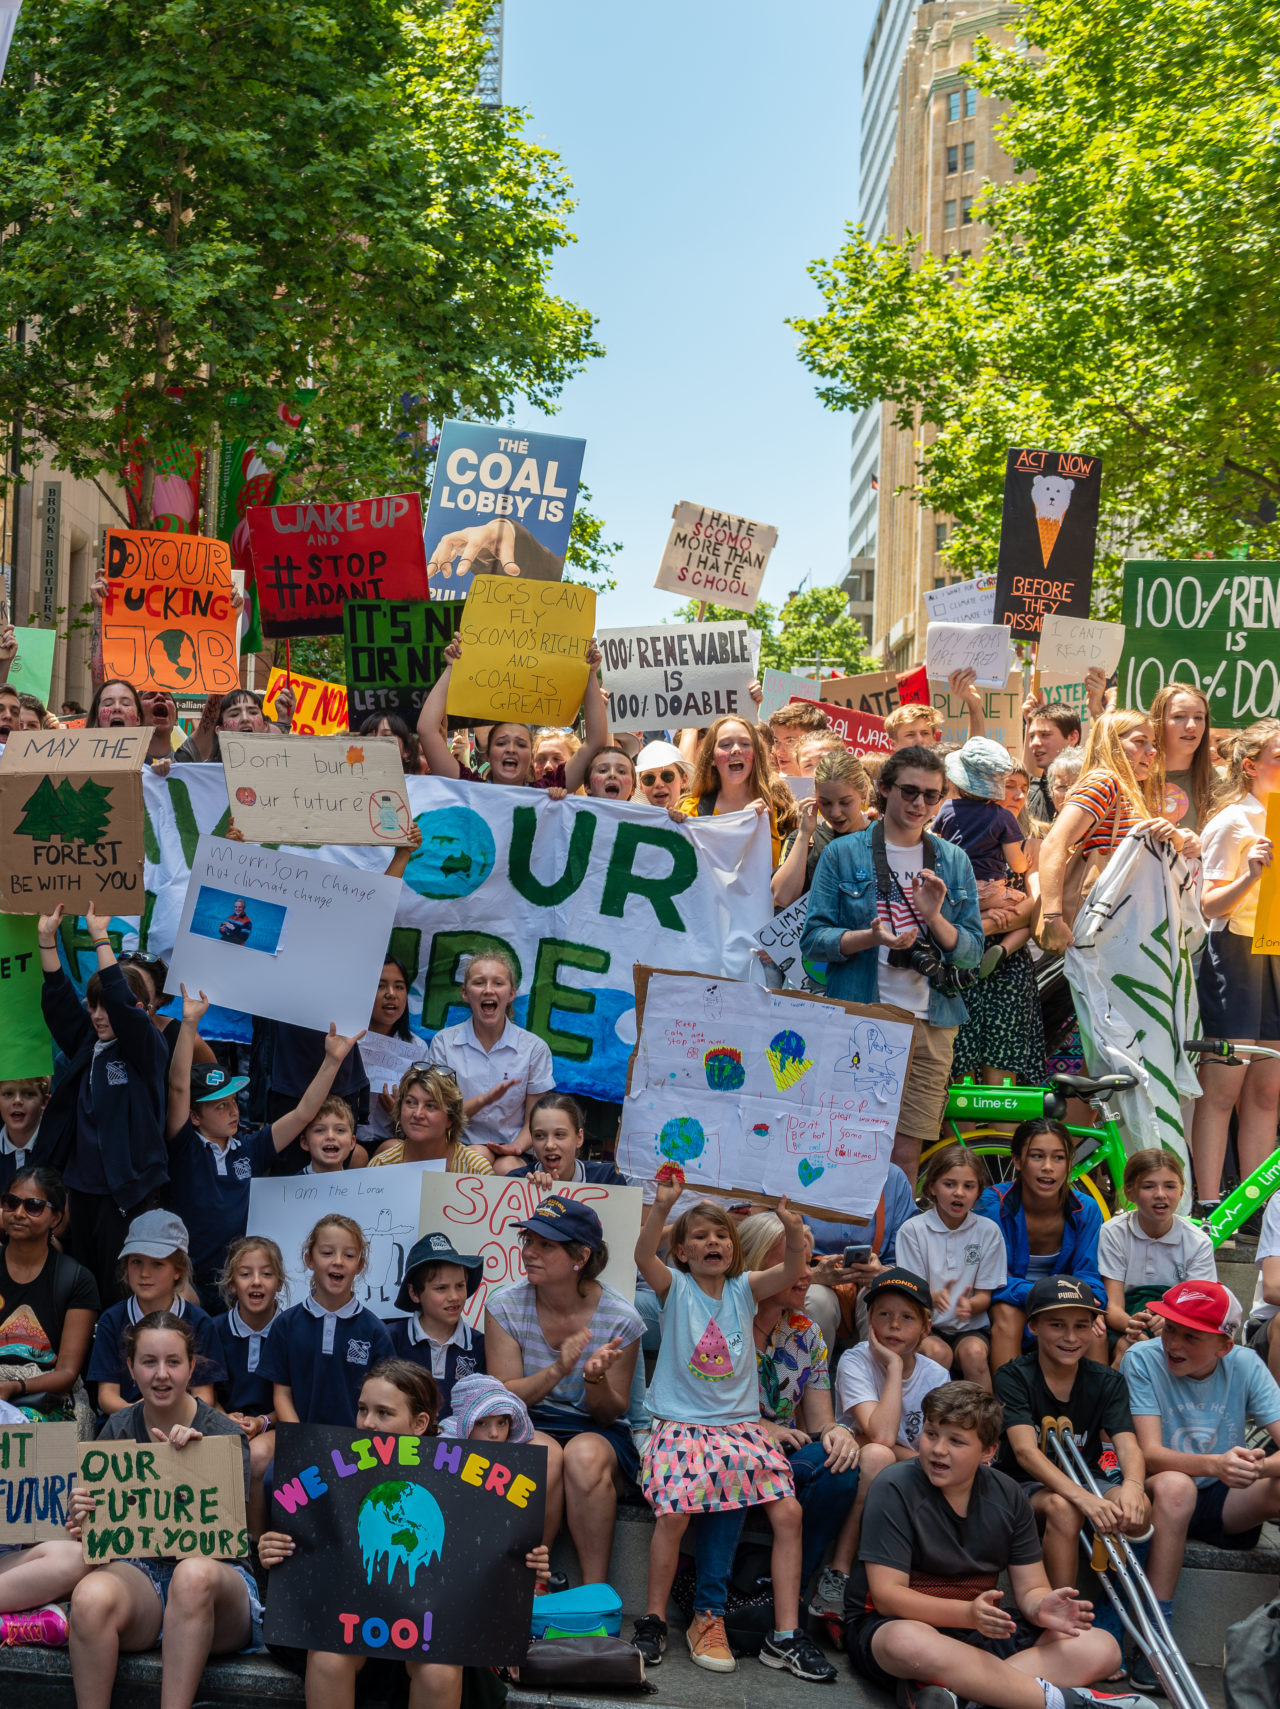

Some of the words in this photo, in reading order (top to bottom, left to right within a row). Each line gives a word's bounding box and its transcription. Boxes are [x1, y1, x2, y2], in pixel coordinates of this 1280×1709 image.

[497, 437, 530, 454] THE
[445, 447, 569, 499] COAL
[1017, 450, 1049, 469] ACT
[1058, 454, 1094, 475] NOW
[47, 488, 56, 544] BROOKS
[270, 502, 363, 534] WAKE
[370, 497, 410, 528] UP
[439, 486, 533, 518] LOBBY
[538, 499, 565, 523] IS
[692, 522, 752, 551] SCOMO
[699, 508, 705, 522] I
[710, 511, 758, 538] HATE
[306, 533, 340, 547] AND
[674, 532, 721, 557] MORE
[727, 546, 766, 570] THAN
[108, 535, 140, 579] DO
[141, 537, 234, 587] YOUR
[307, 550, 388, 580] STOP
[697, 554, 745, 580] HATE
[43, 549, 54, 624] BROTHERS
[304, 578, 385, 606] ADANI
[471, 579, 531, 606] PIGS
[540, 586, 586, 613] CAN
[677, 567, 749, 597] SCHOOL
[1013, 576, 1075, 599] BEFORE
[104, 582, 230, 621] FUCKING
[1023, 598, 1060, 614] THEY
[348, 602, 412, 645] IT'S
[509, 608, 546, 626] FLY
[463, 624, 537, 650] SCOMO'S
[540, 632, 591, 656] RIGHT
[636, 629, 751, 669] RENEWABLE
[1056, 643, 1102, 659] READ
[1227, 631, 1248, 652] IS
[104, 624, 238, 692] JOB
[353, 645, 400, 683] OR
[506, 653, 538, 669] AND
[963, 652, 999, 666] TIRED
[530, 674, 558, 695] IS
[664, 670, 683, 693] IS
[354, 688, 400, 711] LETS
[489, 691, 562, 718] GREAT!
[655, 689, 738, 718] DOABLE
[934, 692, 1019, 719] PLANET
[23, 737, 80, 759] MAY
[88, 737, 138, 759] THE
[227, 742, 291, 768] Don't
[293, 788, 363, 812] future
[33, 841, 124, 867] FOREST
[210, 847, 309, 881] Morrison
[10, 874, 33, 894] BE
[38, 874, 81, 891] WITH
[96, 871, 137, 893] YOU
[233, 870, 290, 896] climate
[294, 1186, 318, 1199] am
[328, 1184, 349, 1197] the
[357, 1181, 385, 1197] Lorax
[1058, 1291, 1081, 1300] PUMA
[81, 1450, 161, 1483] OUR
[274, 1465, 328, 1514] WE
[331, 1435, 420, 1478] LIVE
[433, 1441, 537, 1508] HERE
[88, 1484, 219, 1525] FUTURE
[163, 1527, 248, 1558] YOURS
[339, 1611, 433, 1651] TOO!
